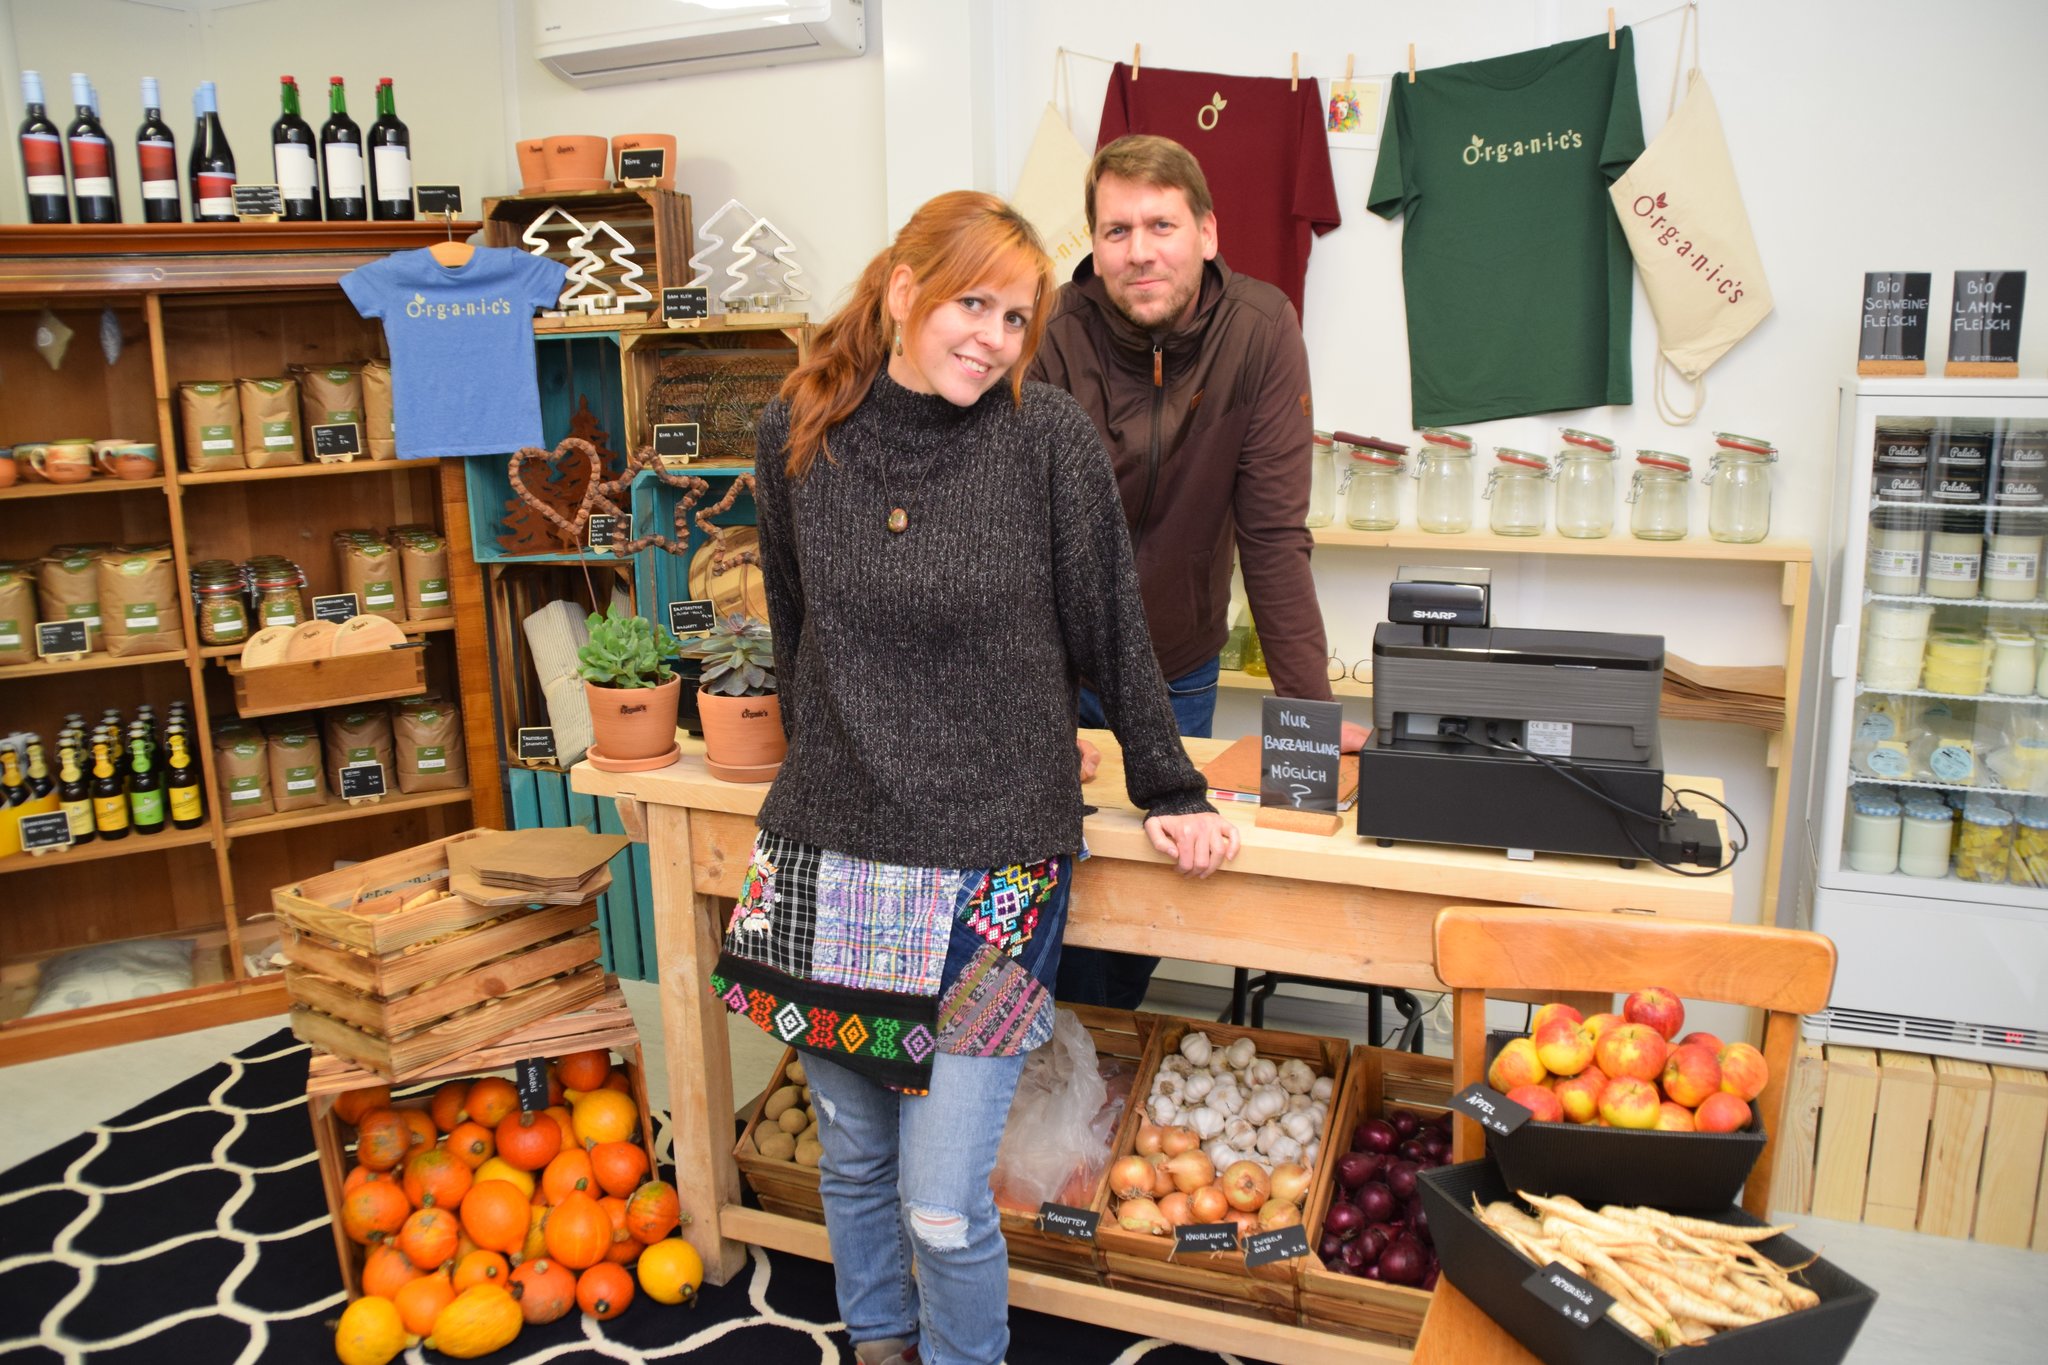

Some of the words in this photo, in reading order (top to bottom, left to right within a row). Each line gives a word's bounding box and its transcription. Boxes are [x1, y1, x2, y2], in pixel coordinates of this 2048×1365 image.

[1413, 610, 1457, 619] SHARP
[1280, 710, 1310, 729] NUR
[1264, 735, 1340, 760] BARZAHLUNG
[1465, 1092, 1496, 1115] ÄPFEL
[1047, 1211, 1087, 1227] KAROTTEN
[1185, 1232, 1227, 1241] KNOBLAUCH
